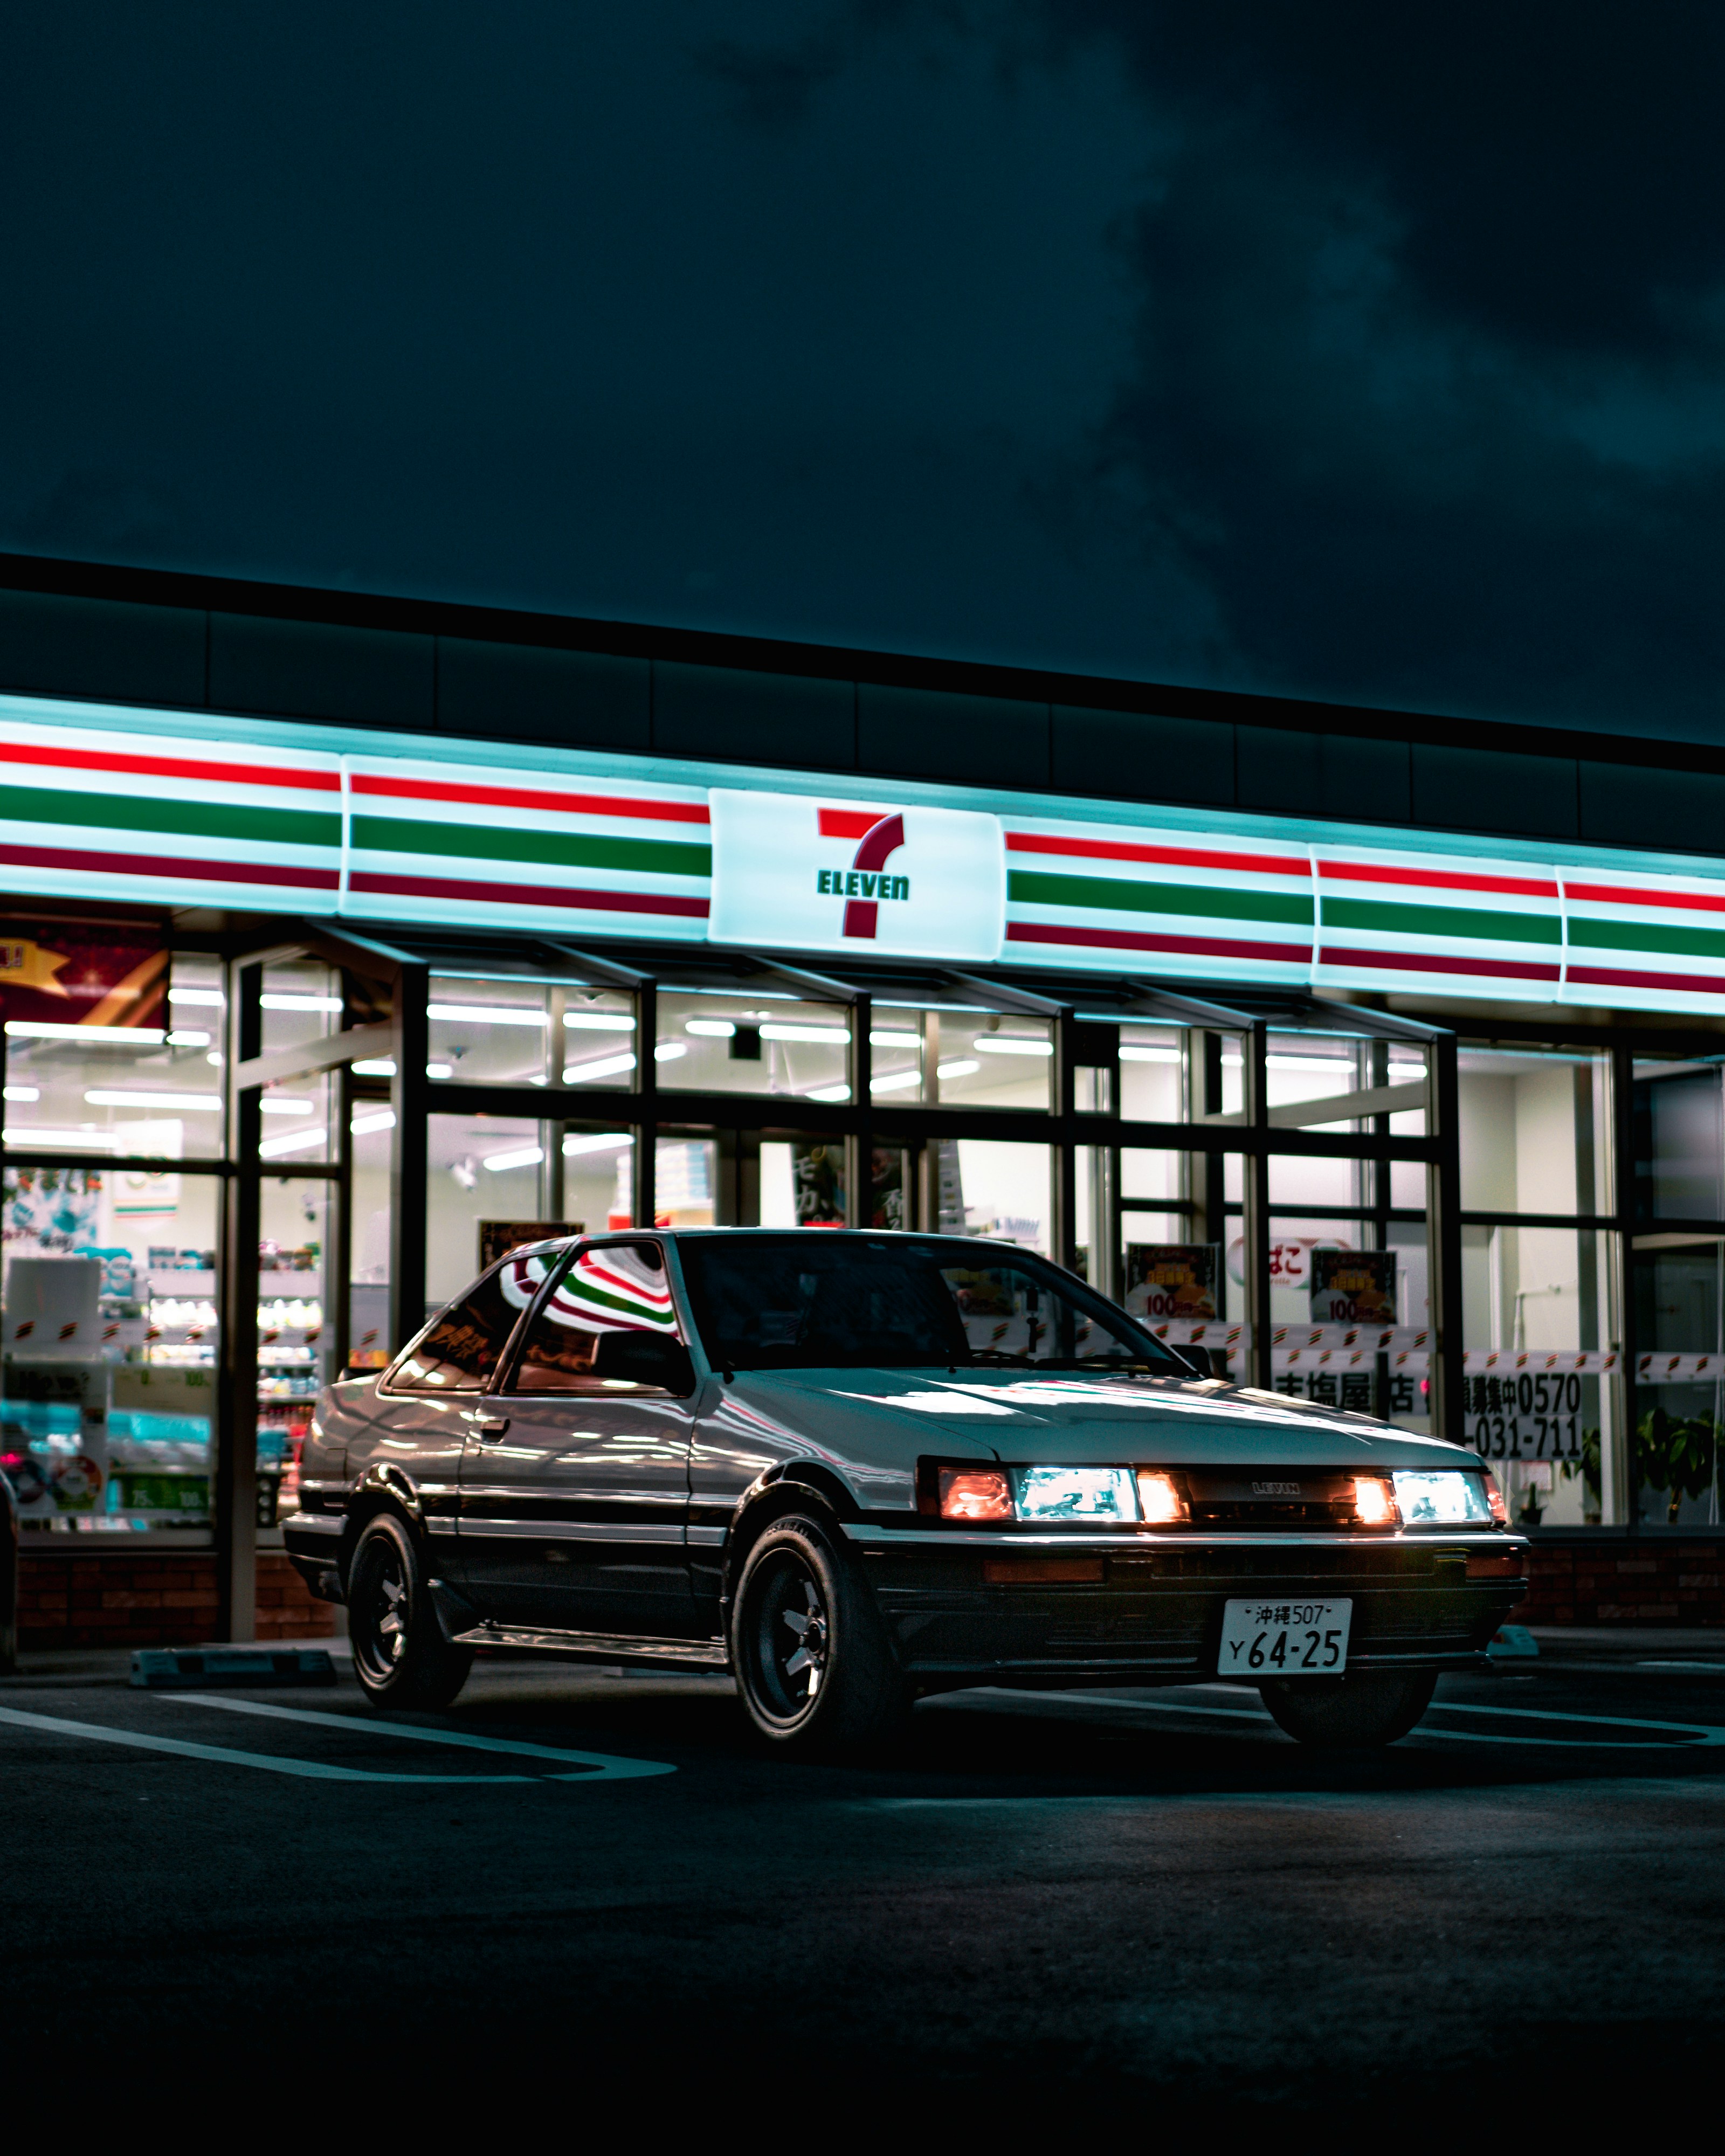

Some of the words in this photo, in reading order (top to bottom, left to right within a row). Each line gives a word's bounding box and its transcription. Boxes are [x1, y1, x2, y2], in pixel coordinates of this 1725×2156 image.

[817, 807, 905, 939] 7
[817, 869, 909, 900] ELEVEn
[1252, 1482, 1301, 1494] LEVIN
